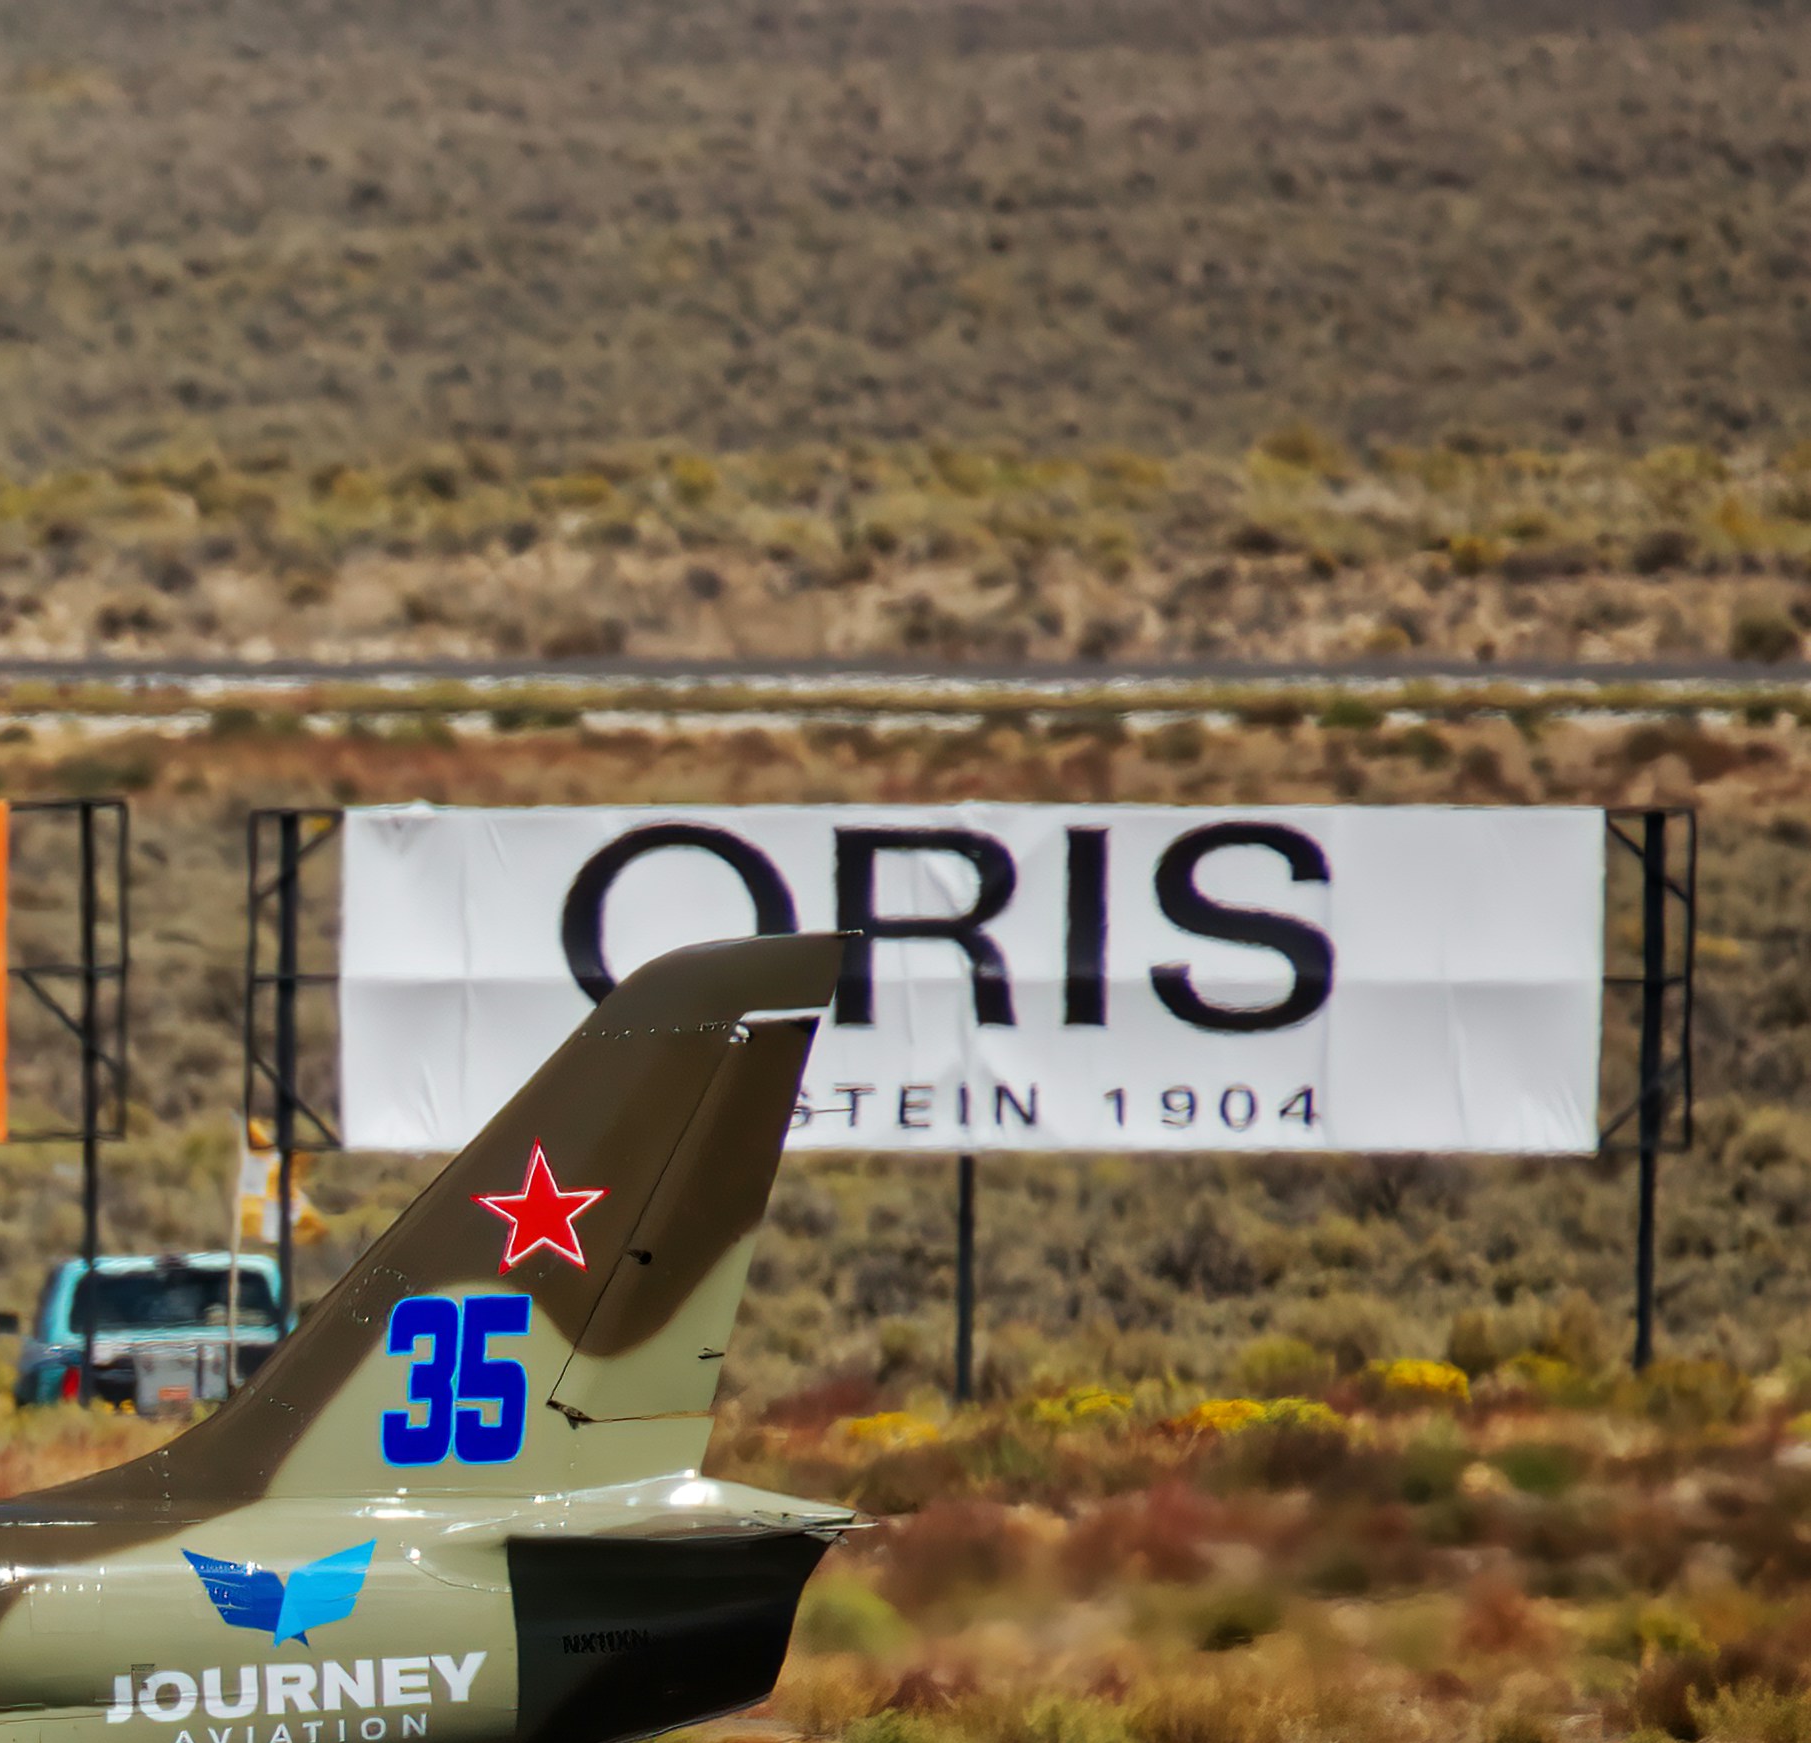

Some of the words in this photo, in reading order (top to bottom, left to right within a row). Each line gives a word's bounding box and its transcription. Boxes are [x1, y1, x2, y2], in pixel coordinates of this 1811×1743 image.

[558, 820, 1334, 1034] ORIS
[1102, 1084, 1320, 1128] 1904
[380, 1292, 534, 1469] 35
[104, 1650, 488, 1725] JOURNEY
